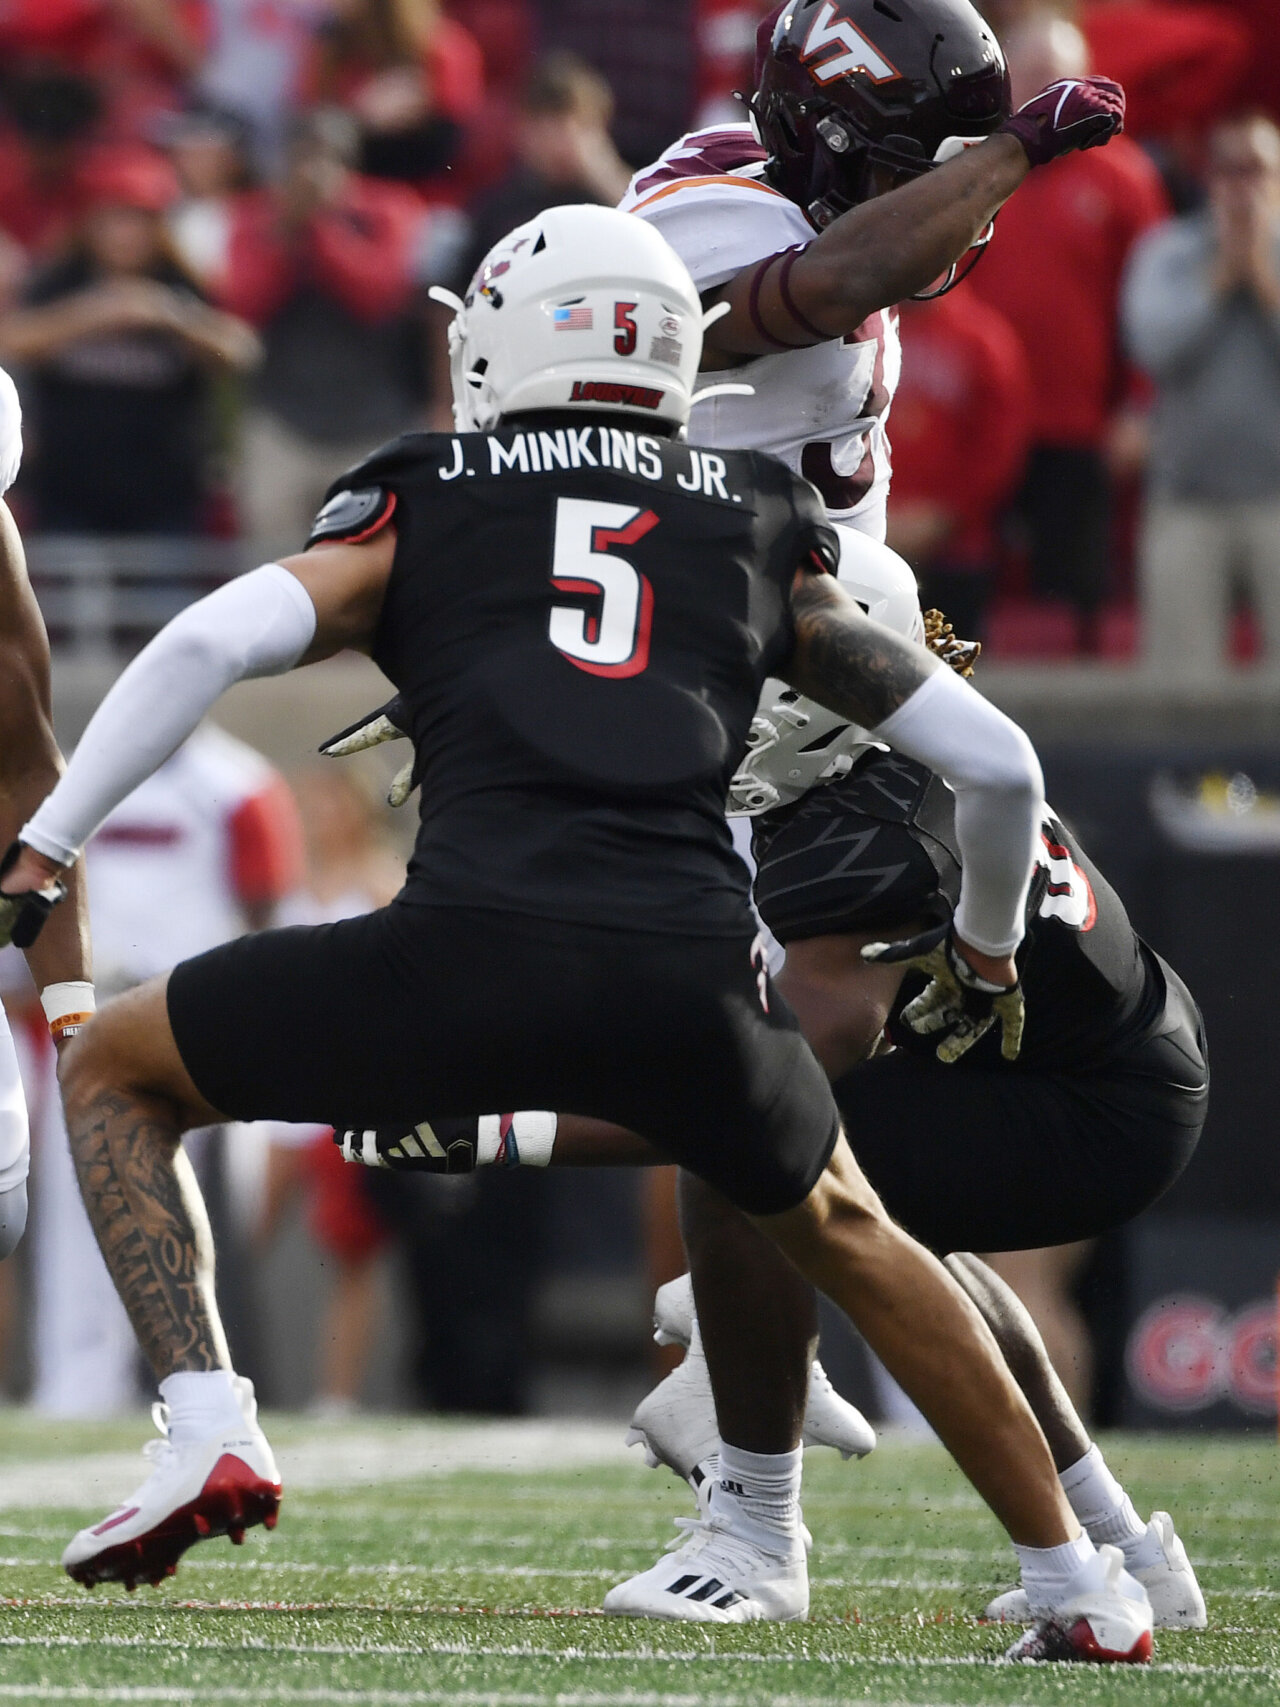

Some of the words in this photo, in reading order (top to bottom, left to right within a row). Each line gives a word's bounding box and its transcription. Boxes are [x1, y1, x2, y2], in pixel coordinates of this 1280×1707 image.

[613, 301, 638, 357] 5
[438, 438, 476, 481] J.
[486, 426, 663, 481] MINKINS
[676, 450, 743, 503] JR.
[547, 496, 661, 680] 5
